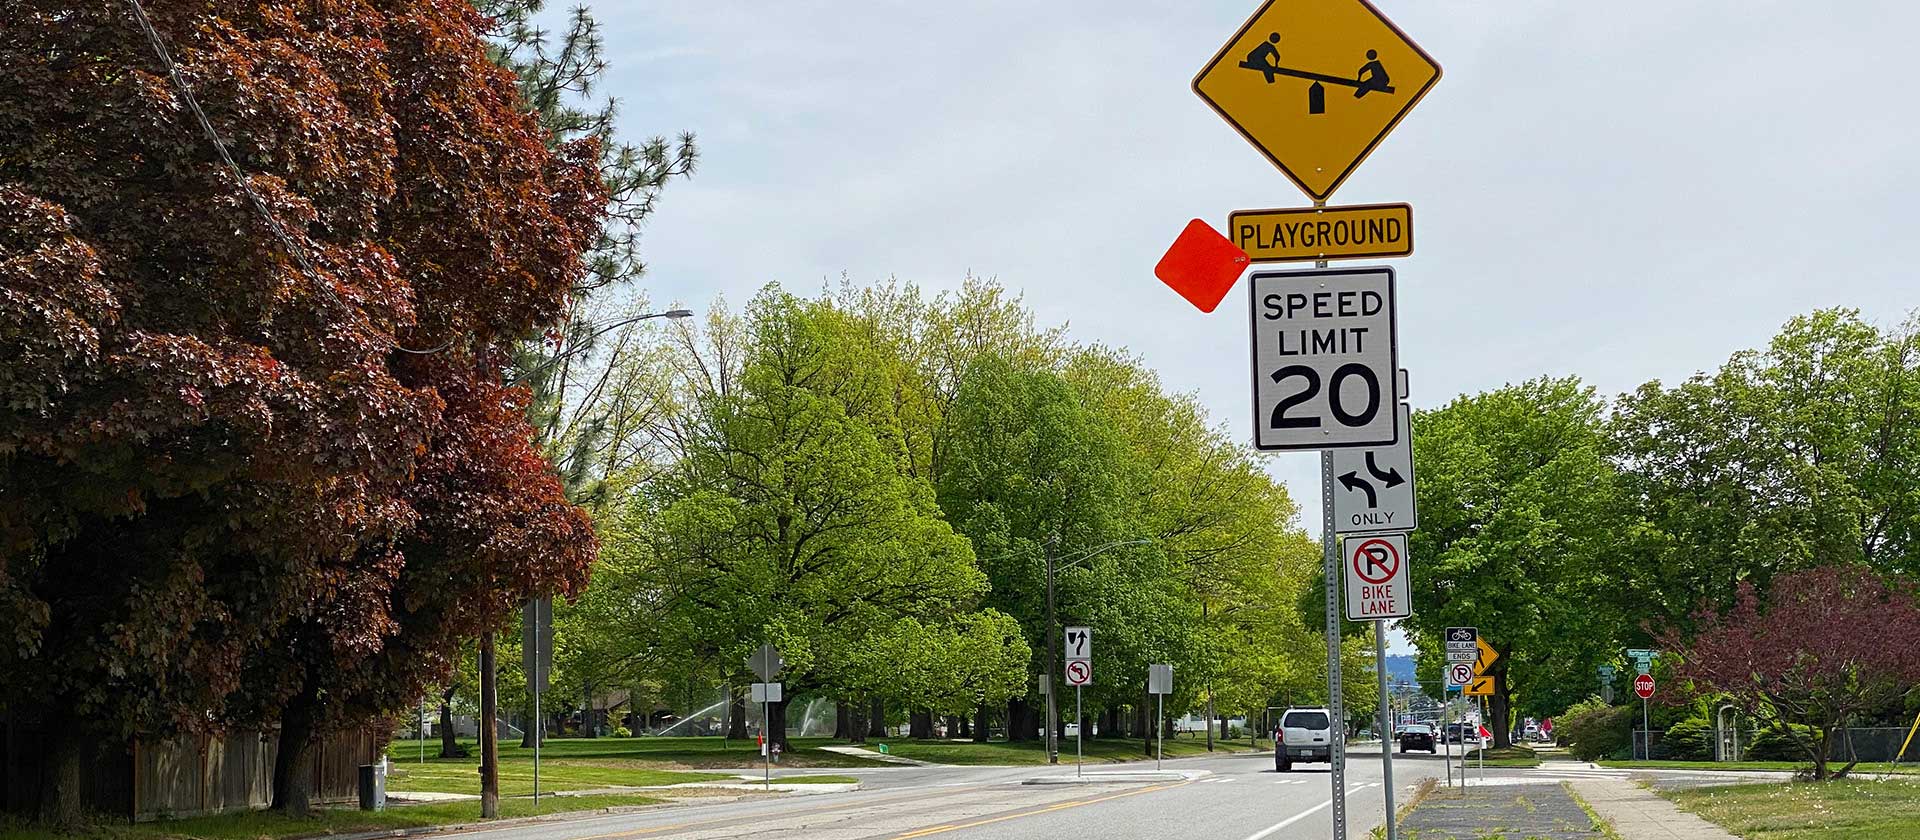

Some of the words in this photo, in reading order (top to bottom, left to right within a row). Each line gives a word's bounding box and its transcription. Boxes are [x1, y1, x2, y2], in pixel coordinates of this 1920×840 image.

[1240, 217, 1401, 250] PLAYGROUND
[1263, 290, 1383, 321] SPEED
[1278, 327, 1369, 356] LIMIT
[1270, 362, 1381, 430] 20
[1351, 511, 1395, 526] ONLY
[1362, 584, 1394, 600] BIKE
[1361, 599, 1396, 615] LANE
[1636, 681, 1653, 691] STOP
